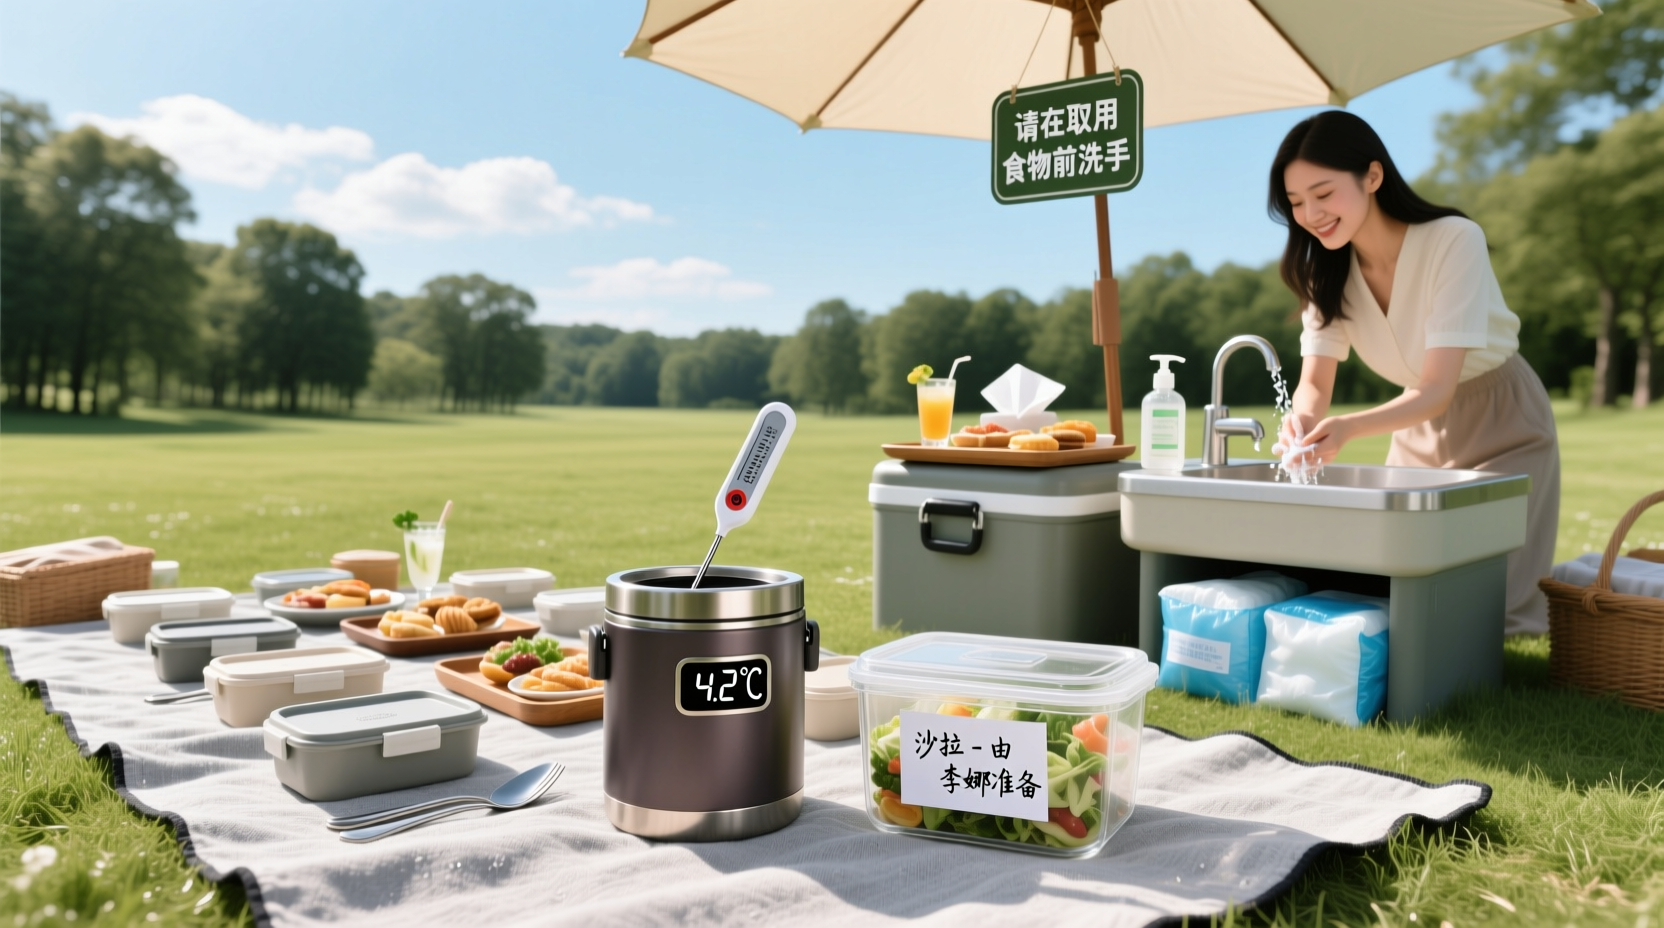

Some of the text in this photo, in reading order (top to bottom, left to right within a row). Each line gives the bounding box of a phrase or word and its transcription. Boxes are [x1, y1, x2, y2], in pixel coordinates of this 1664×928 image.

[1014, 97, 1118, 143] 请在取用
[1002, 138, 1131, 185] 食物前洗手
[940, 763, 1042, 800] 李娜准备
